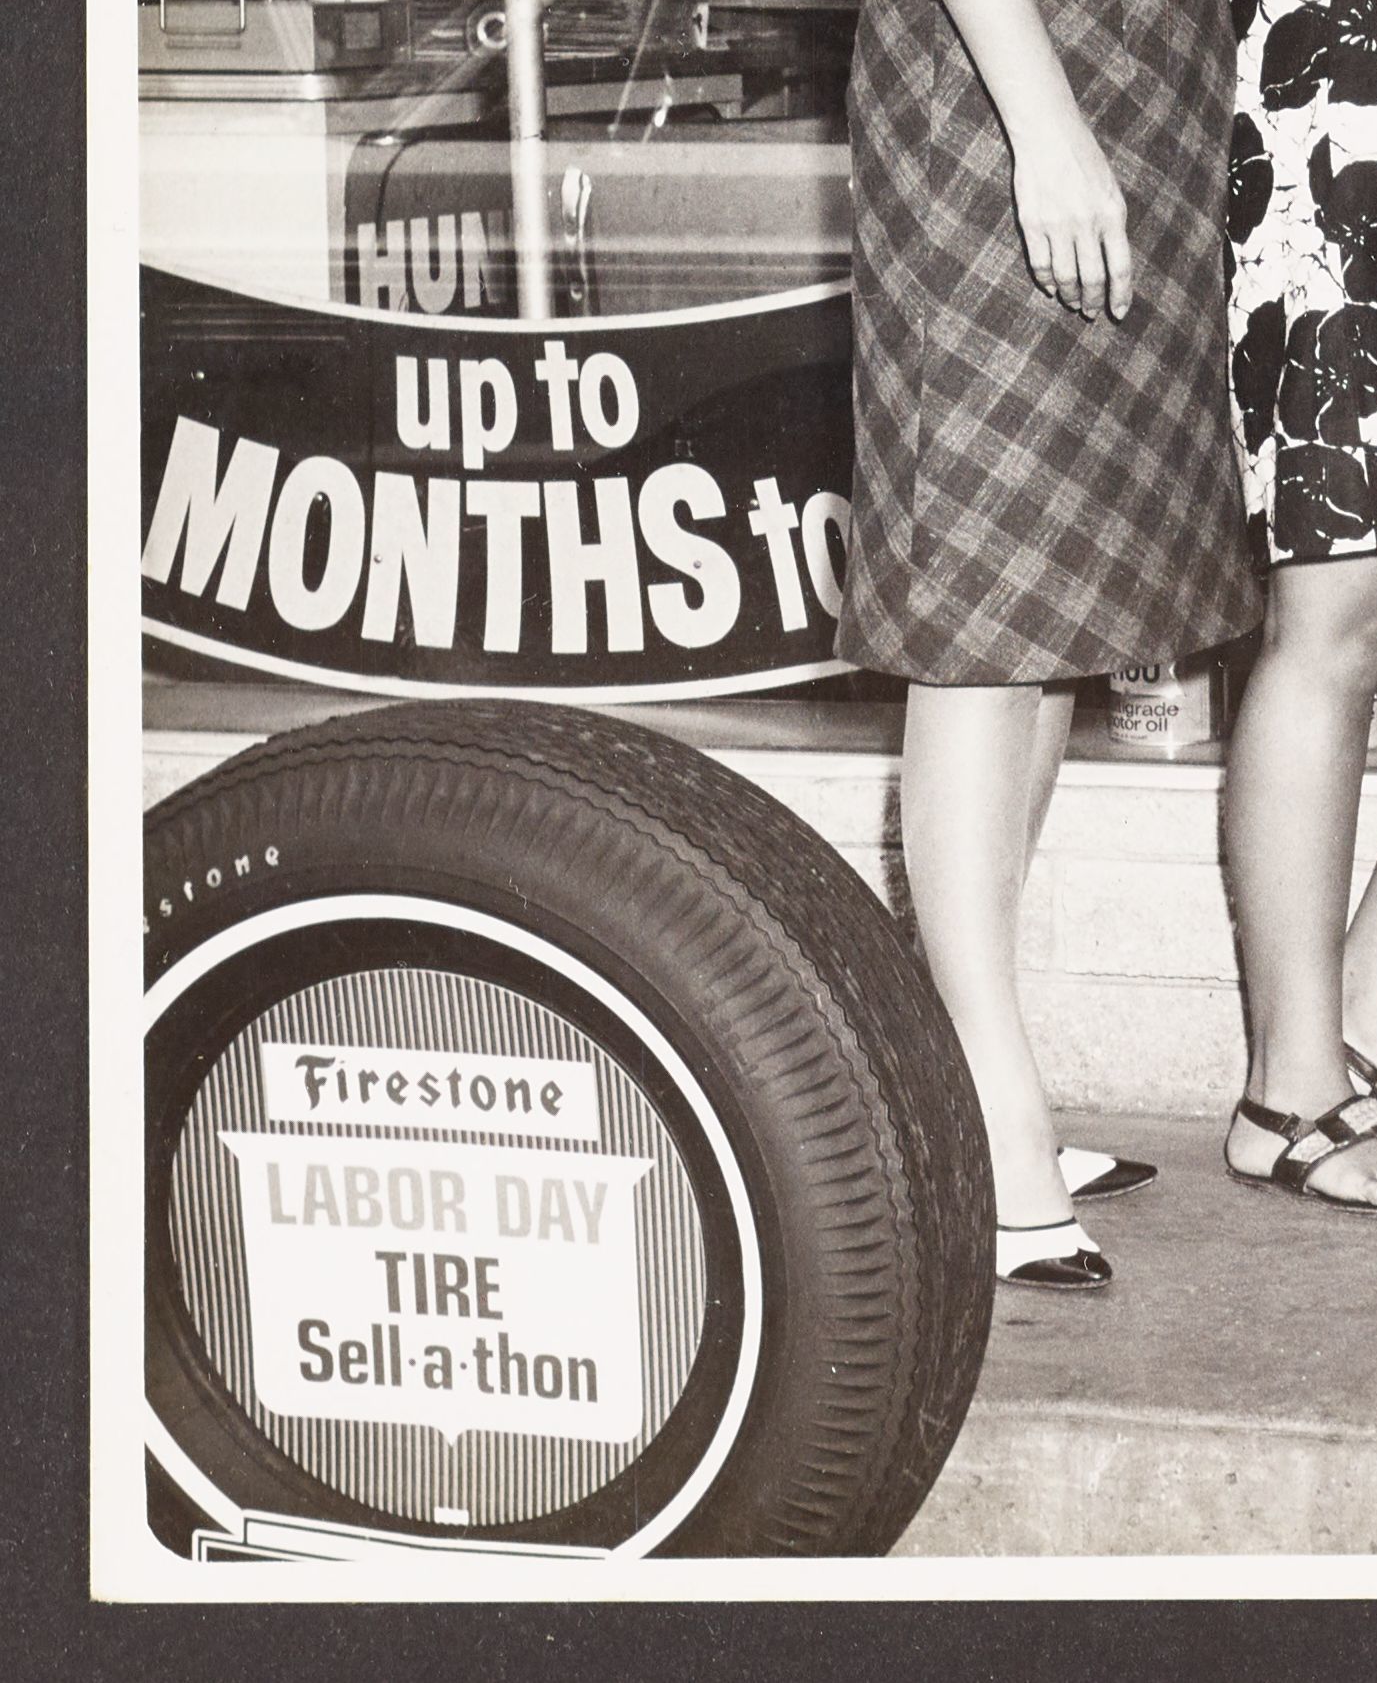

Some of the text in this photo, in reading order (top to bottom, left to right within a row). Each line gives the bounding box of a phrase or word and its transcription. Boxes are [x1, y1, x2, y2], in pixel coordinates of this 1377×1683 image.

[396, 341, 639, 470] up to
[141, 415, 850, 655] MONTHS to
[1146, 718, 1168, 732] oil
[294, 1053, 564, 1116] Firestone
[266, 1160, 608, 1244] LABOR DAY
[375, 1251, 503, 1321] TIRE
